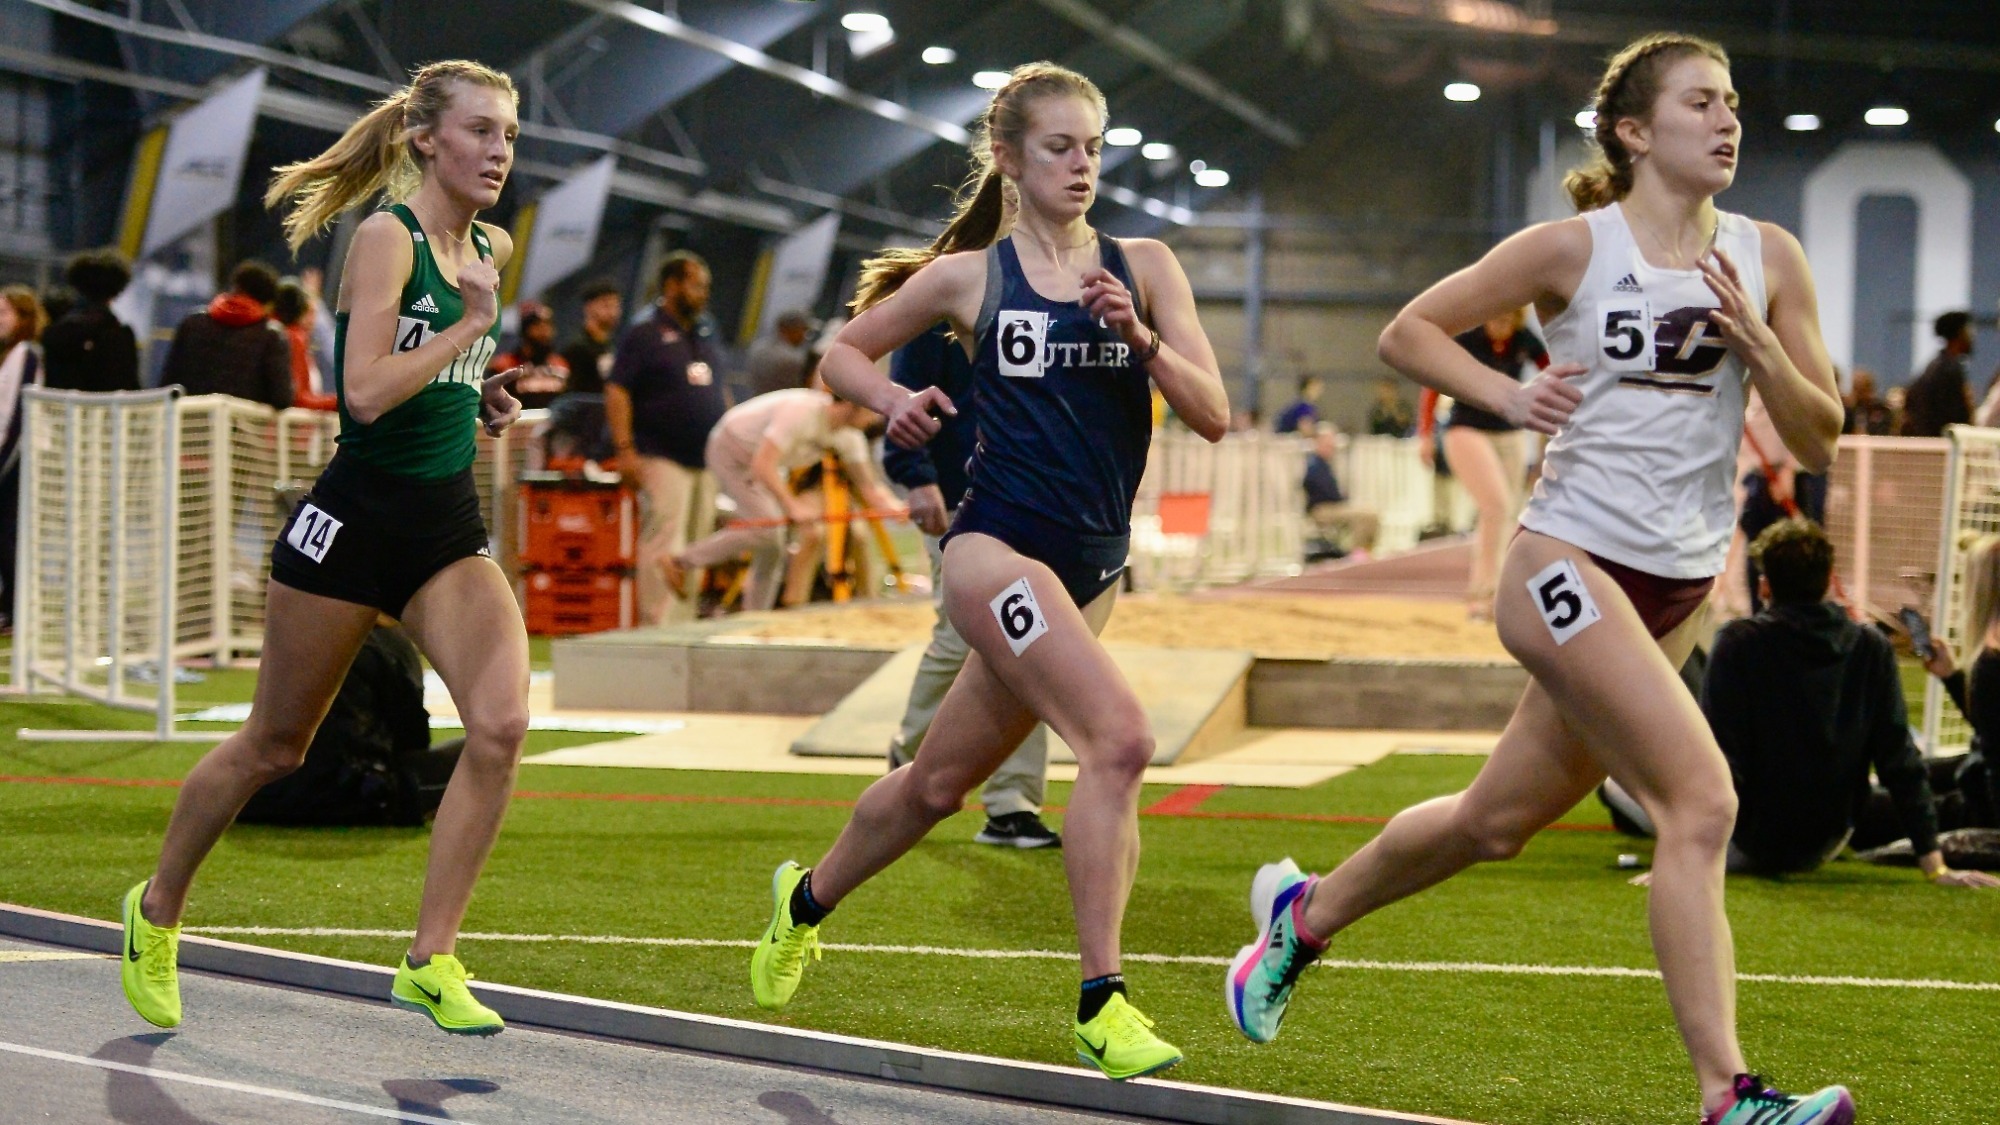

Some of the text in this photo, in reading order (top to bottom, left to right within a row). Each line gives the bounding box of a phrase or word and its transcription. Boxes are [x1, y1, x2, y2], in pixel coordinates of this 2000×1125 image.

[411, 304, 439, 313] adidas
[1613, 285, 1643, 293] adidas
[1001, 320, 1036, 366] 6
[1045, 342, 1130, 368] UTLER
[1603, 310, 1644, 360] 5
[300, 510, 333, 558] 14
[1001, 593, 1034, 641] 6
[1539, 572, 1582, 629] 5
